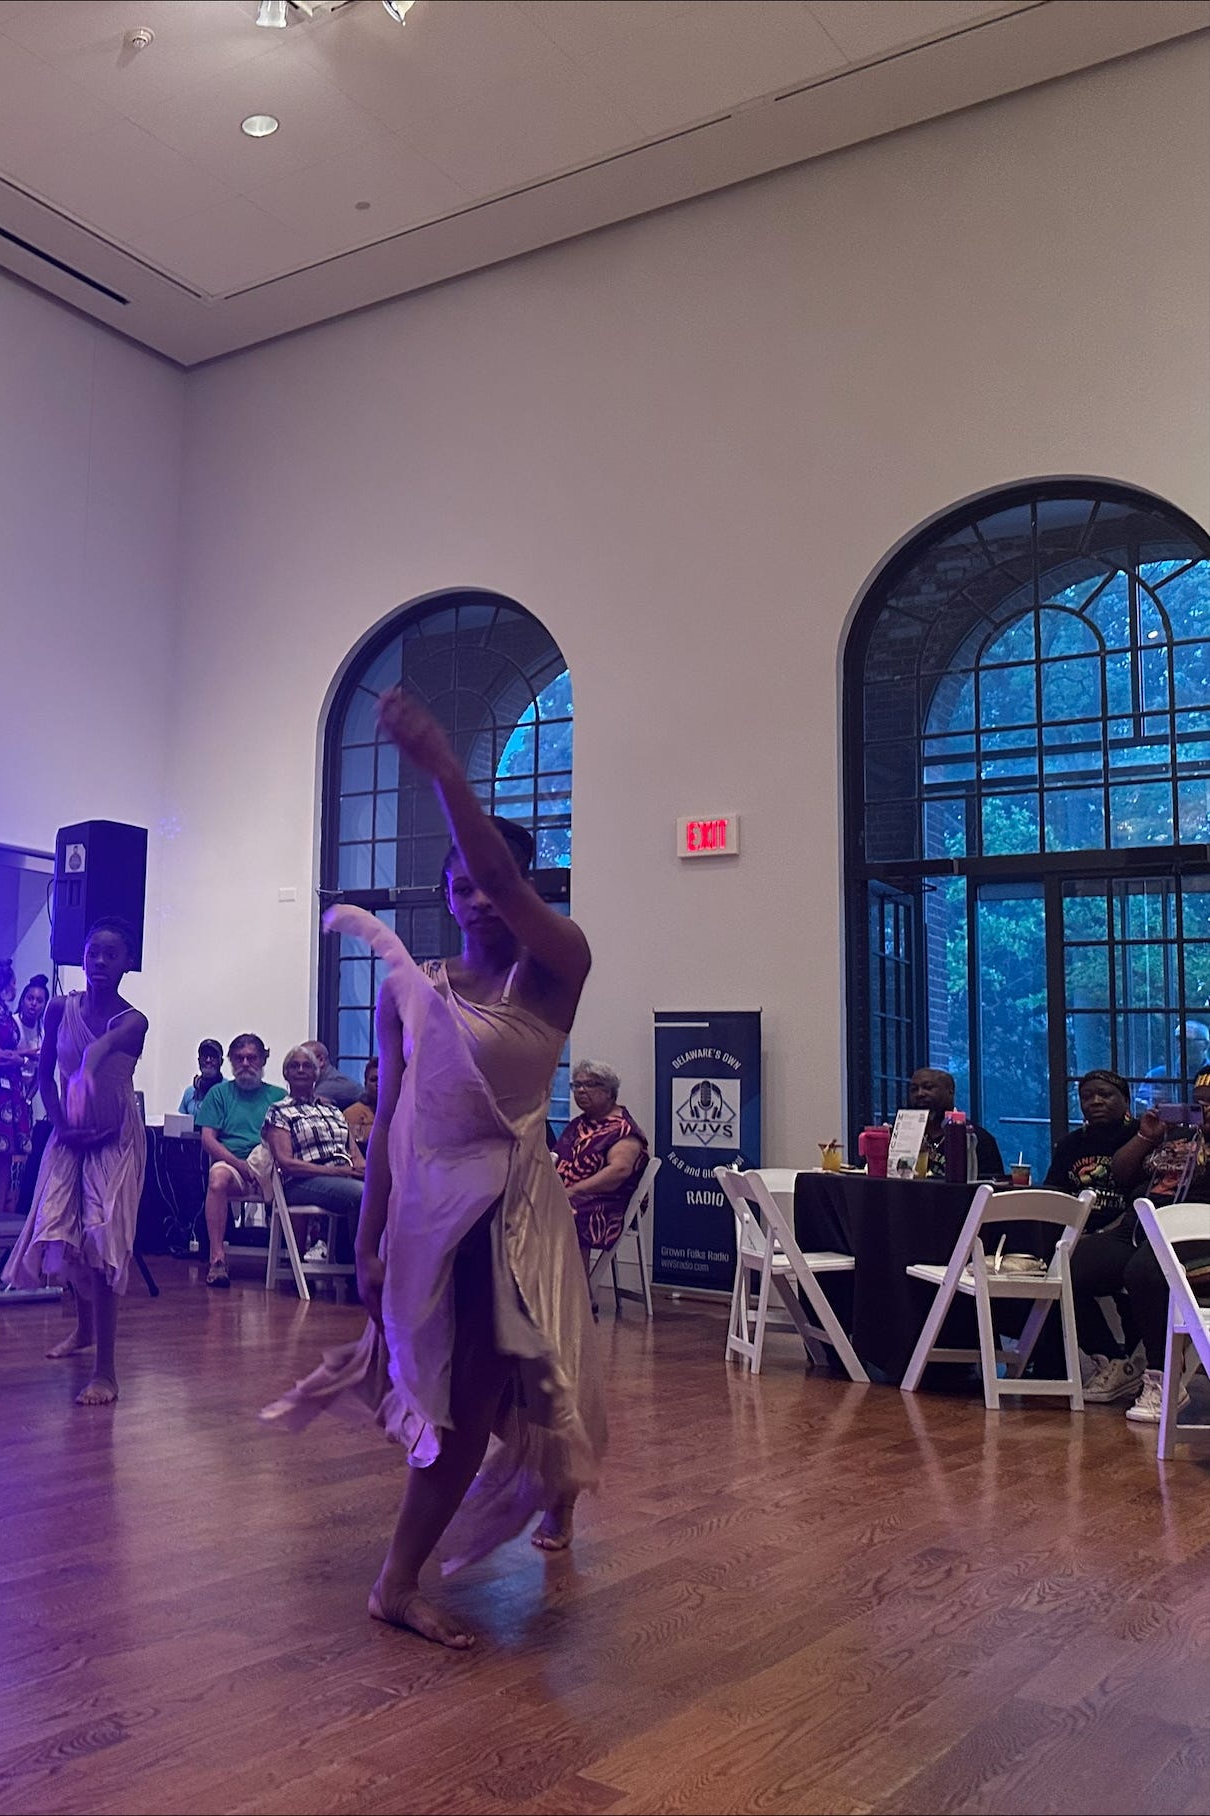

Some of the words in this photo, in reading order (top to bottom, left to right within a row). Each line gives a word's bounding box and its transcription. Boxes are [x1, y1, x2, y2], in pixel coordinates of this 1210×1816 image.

[686, 819, 728, 852] EXIT
[671, 1048, 722, 1069] DELAWARE'S
[722, 1052, 742, 1070] OWN
[679, 1122, 733, 1138] WJVS
[667, 1151, 685, 1170] R&B
[683, 1165, 701, 1178] and
[686, 1190, 725, 1207] RADIO
[707, 1250, 730, 1263] Radio
